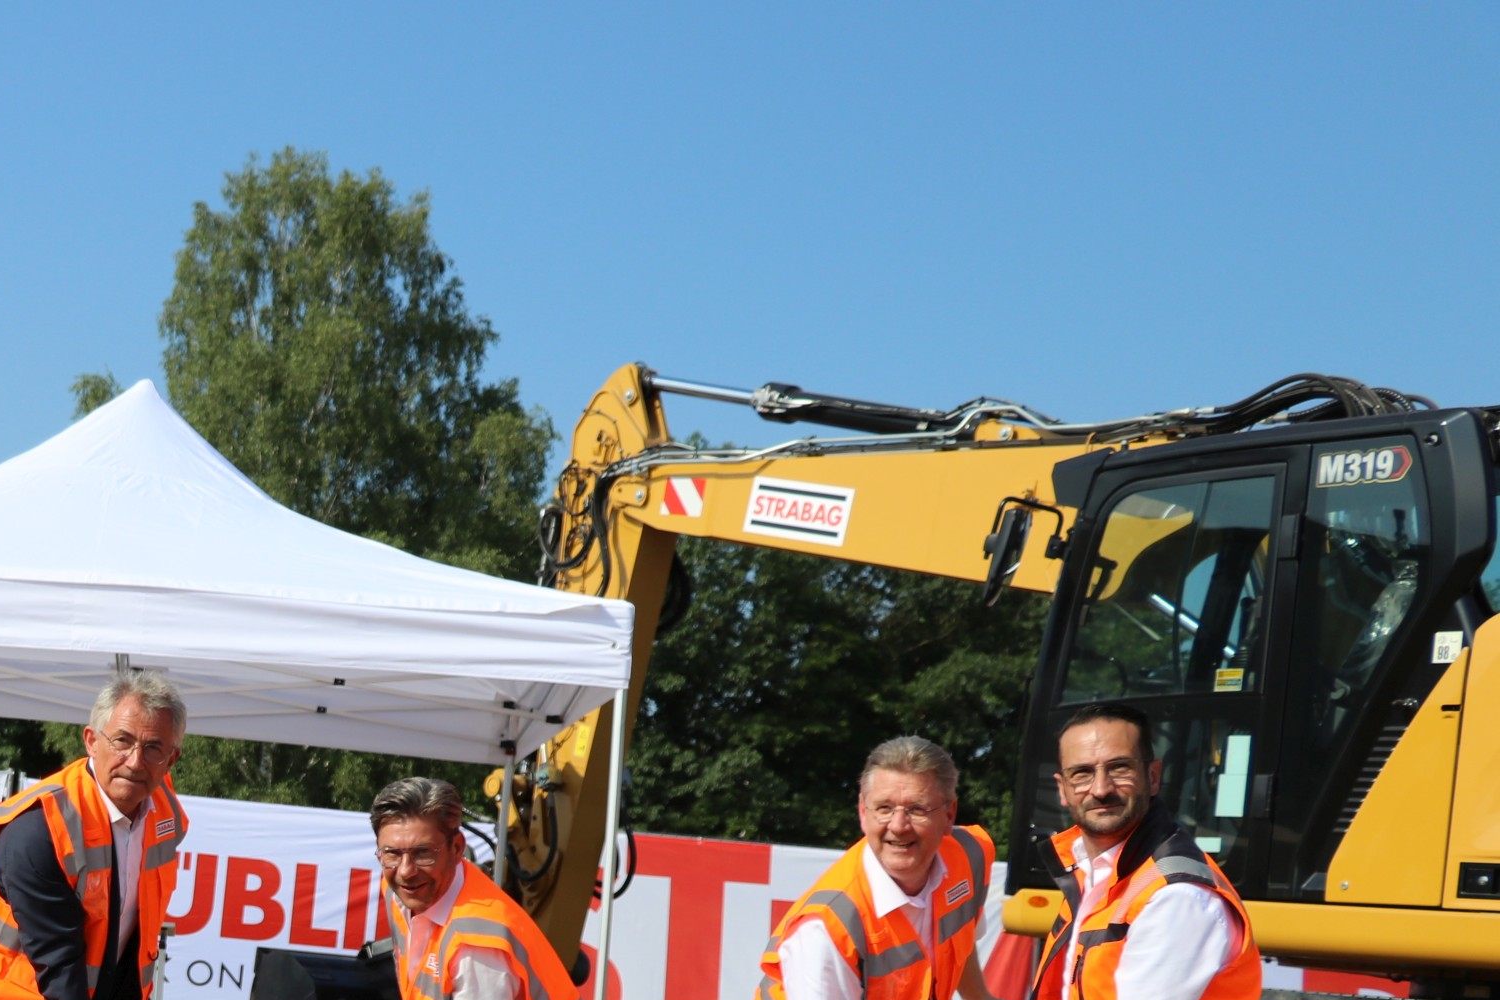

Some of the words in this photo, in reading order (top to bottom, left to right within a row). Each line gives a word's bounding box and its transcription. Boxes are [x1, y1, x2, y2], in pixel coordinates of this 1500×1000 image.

[1319, 449, 1395, 484] M319
[753, 495, 843, 527] STRABAG
[164, 851, 392, 950] ÜBLI
[186, 959, 244, 990] ON
